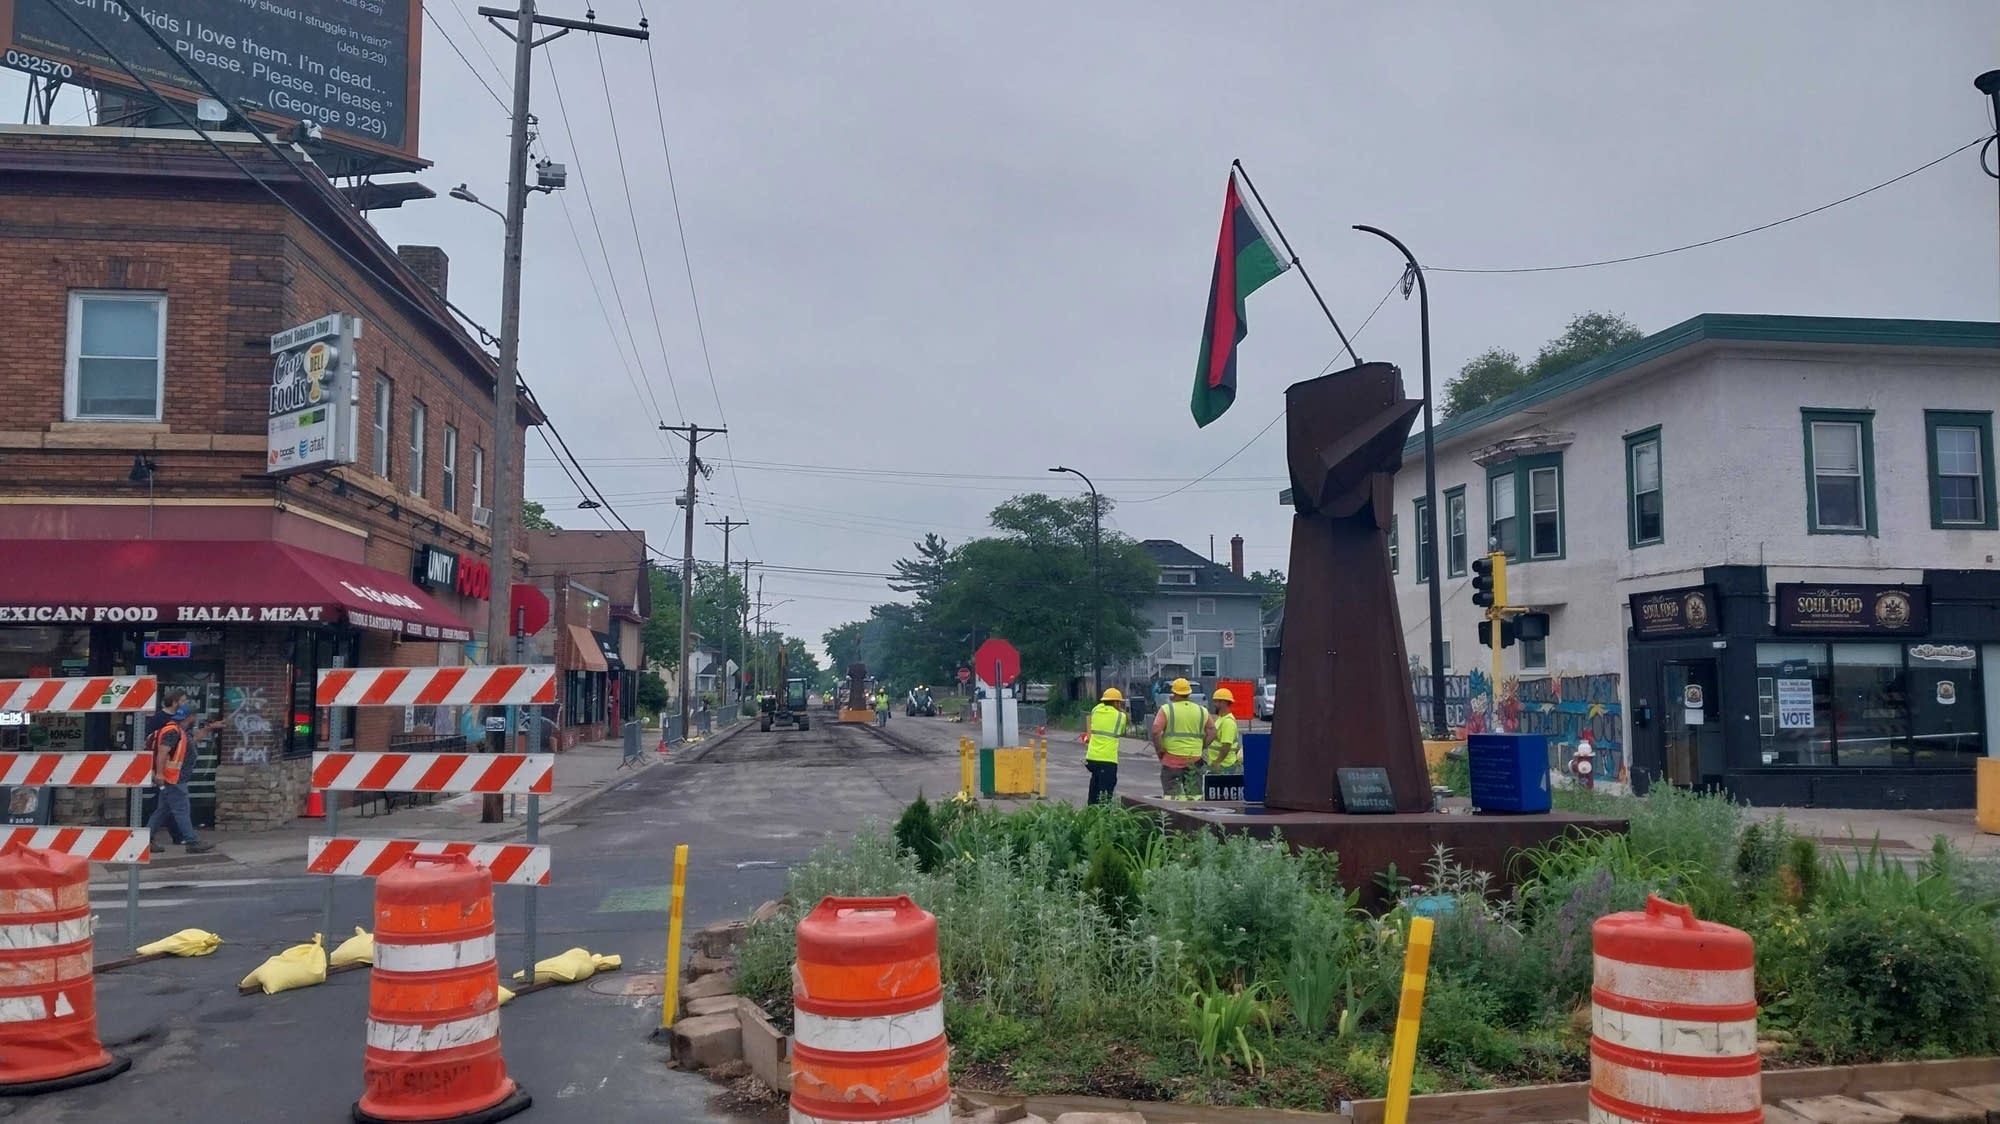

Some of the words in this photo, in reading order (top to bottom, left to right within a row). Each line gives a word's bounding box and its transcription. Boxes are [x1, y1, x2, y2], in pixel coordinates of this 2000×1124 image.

[260, 0, 296, 19] should
[299, 11, 303, 21] I
[304, 15, 347, 36] struggle
[349, 28, 359, 39] in
[6, 50, 73, 79] 032570
[140, 6, 179, 34] kids
[186, 20, 191, 36] I
[197, 24, 237, 50] love
[241, 38, 292, 67] them.
[299, 54, 325, 76] I’m
[329, 65, 387, 95] dead...
[336, 40, 360, 57] (Job
[361, 49, 388, 66] 9:29)
[175, 39, 245, 74] Please.
[252, 62, 319, 96] Please.
[268, 89, 341, 124] (George
[344, 111, 388, 139] 9:29)
[269, 377, 306, 415] Foods
[428, 550, 453, 584] UNITY
[93, 606, 159, 622] FOOD
[177, 606, 254, 622] HALAL
[259, 606, 323, 622] MEAT
[1797, 596, 1829, 613] SOUL
[1831, 597, 1863, 614] FOOD
[146, 642, 189, 657] OPEN
[1782, 712, 1811, 726] VOTE
[1208, 786, 1245, 800] BLACK
